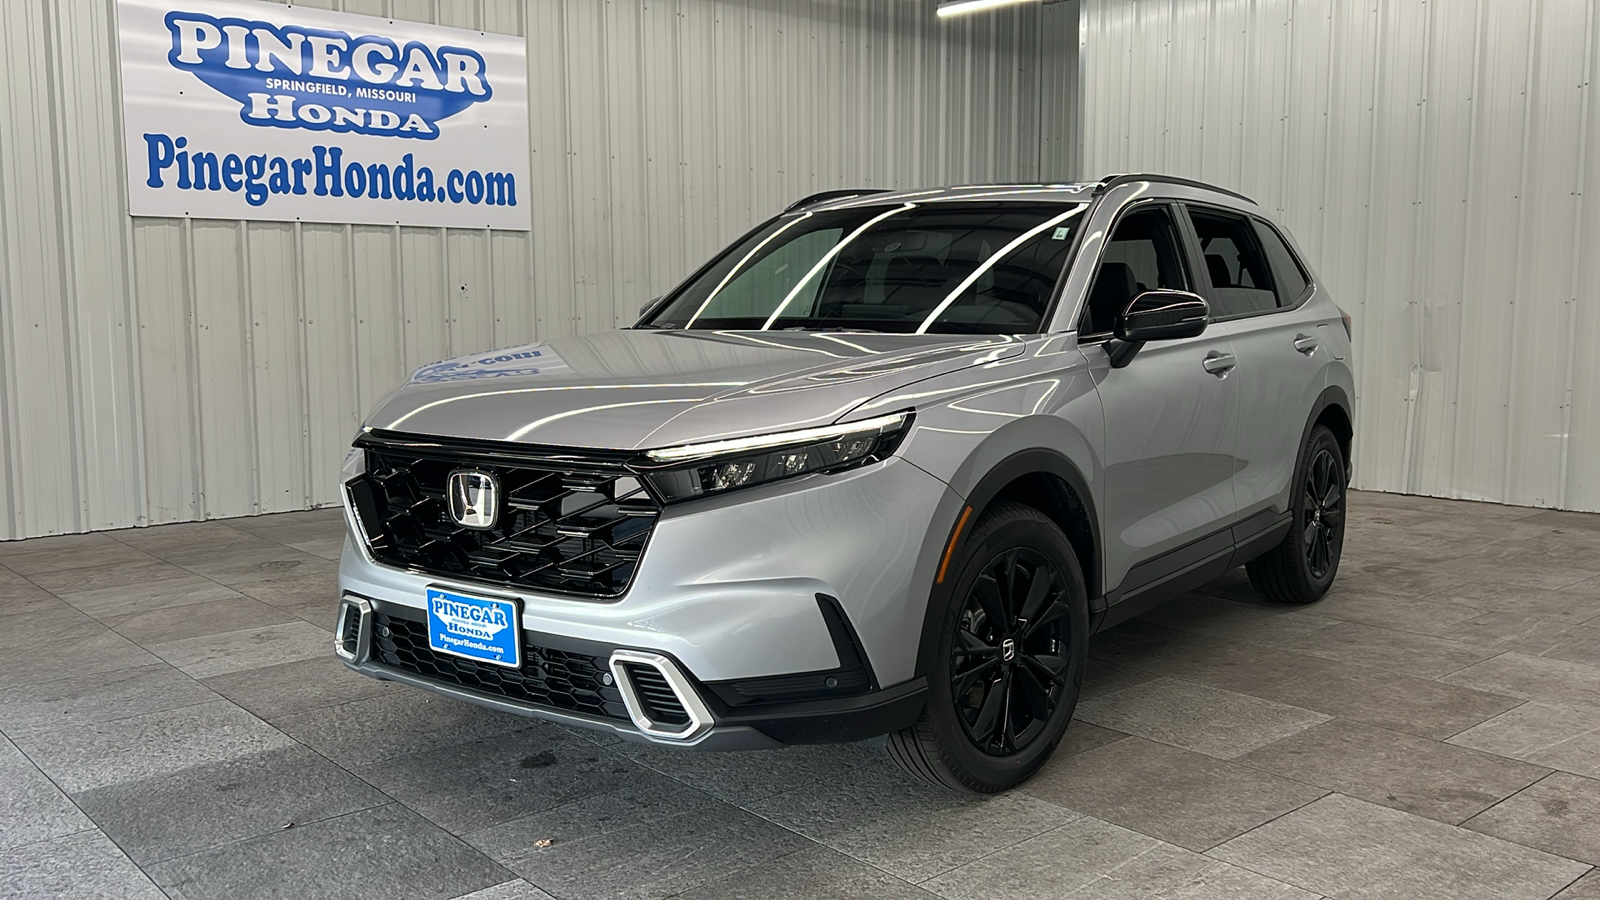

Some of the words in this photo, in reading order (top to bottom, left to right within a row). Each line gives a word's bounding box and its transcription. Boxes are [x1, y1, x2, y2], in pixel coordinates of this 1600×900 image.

[172, 18, 487, 96] PINEGAR
[265, 78, 352, 98] SPRINGFIELD,
[355, 87, 416, 103] MISSOURI
[247, 93, 436, 134] HONDA
[143, 133, 517, 207] PinegarHonda.com
[433, 600, 506, 626] PINEGAR
[439, 633, 504, 653] PinegarHonda.com
[448, 622, 491, 638] HONDA
